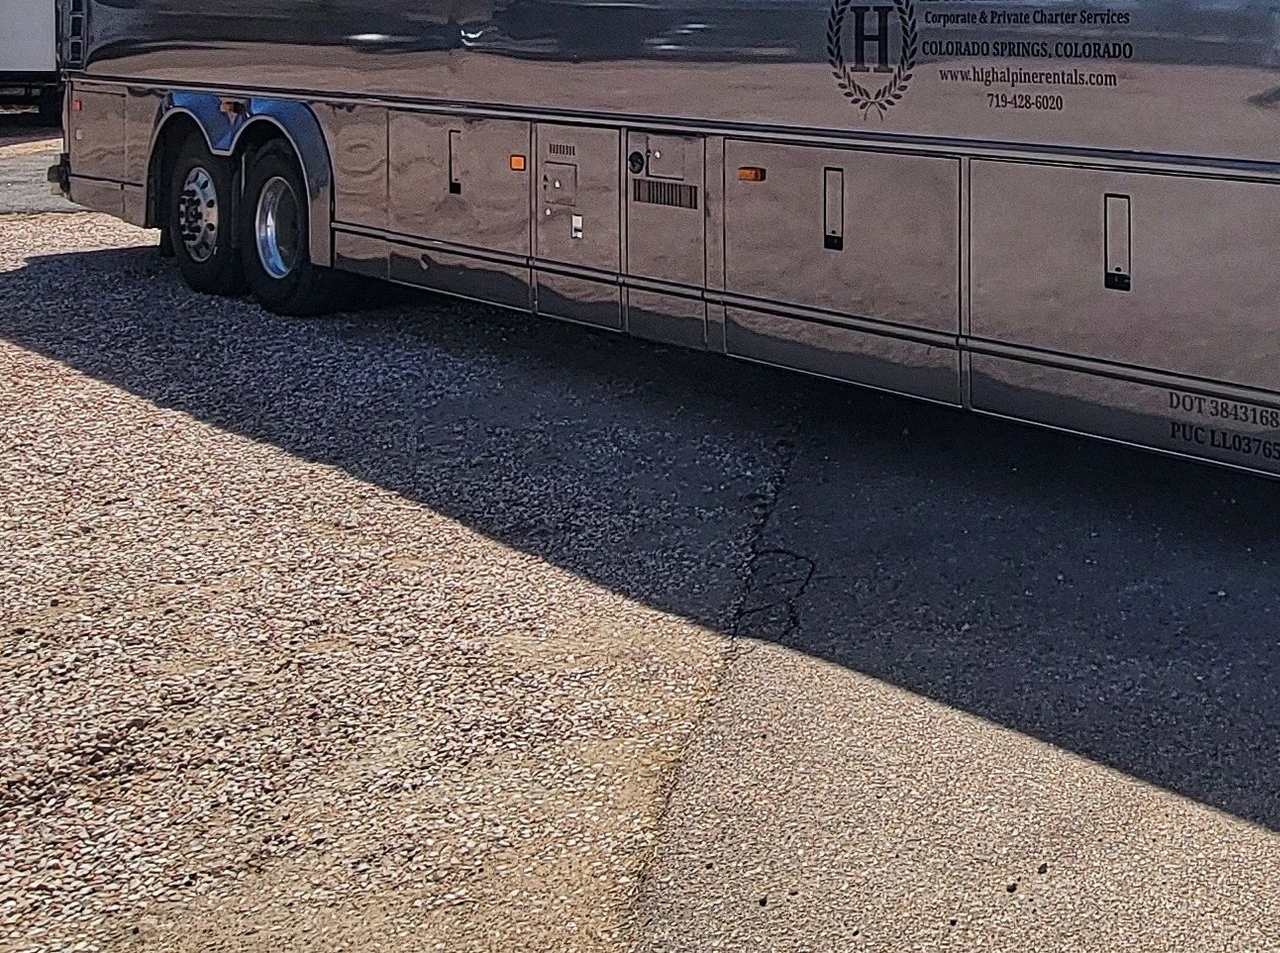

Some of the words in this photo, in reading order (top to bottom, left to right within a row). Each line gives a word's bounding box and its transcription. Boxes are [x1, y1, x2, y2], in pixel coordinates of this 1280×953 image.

[925, 11, 977, 27] Corporate
[980, 10, 988, 24] &
[990, 10, 1030, 24] Private
[1032, 9, 1077, 24] Charter
[1080, 9, 1130, 24] Services
[850, 6, 894, 73] H
[922, 40, 990, 57] COLORADO
[992, 41, 1052, 59] SPRINGS,
[1055, 42, 1133, 59] COLORADO
[939, 66, 1117, 87] www.highalpinerentals.com
[987, 93, 1064, 111] 719-428-6020
[1168, 391, 1206, 414] DOT
[1210, 400, 1280, 429] 3843168
[1170, 421, 1206, 444] PUC
